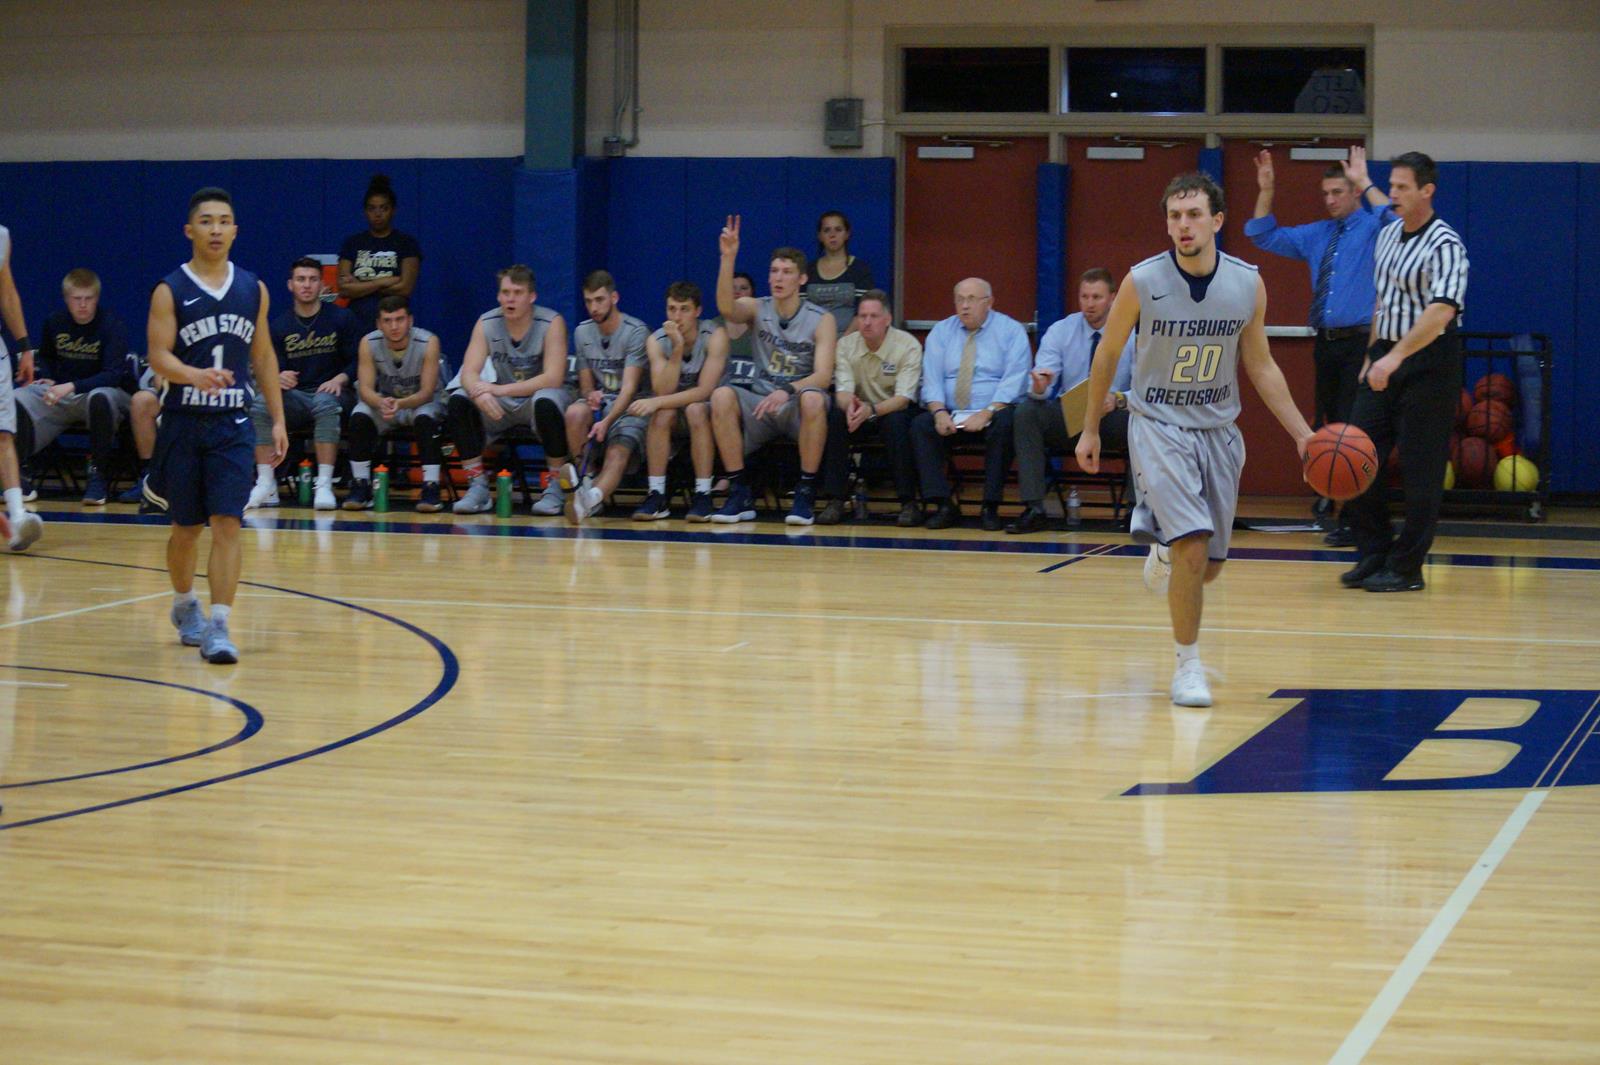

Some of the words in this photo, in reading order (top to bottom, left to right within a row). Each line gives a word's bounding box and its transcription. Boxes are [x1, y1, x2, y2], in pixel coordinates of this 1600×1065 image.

[179, 315, 218, 347] PENN
[218, 313, 255, 344] STATE
[283, 330, 337, 352] Bobcat
[1151, 319, 1244, 337] PITTSBURGH
[211, 345, 224, 380] 1
[767, 350, 797, 376] 55
[1171, 344, 1223, 383] 20
[181, 386, 245, 408] FAYETTE
